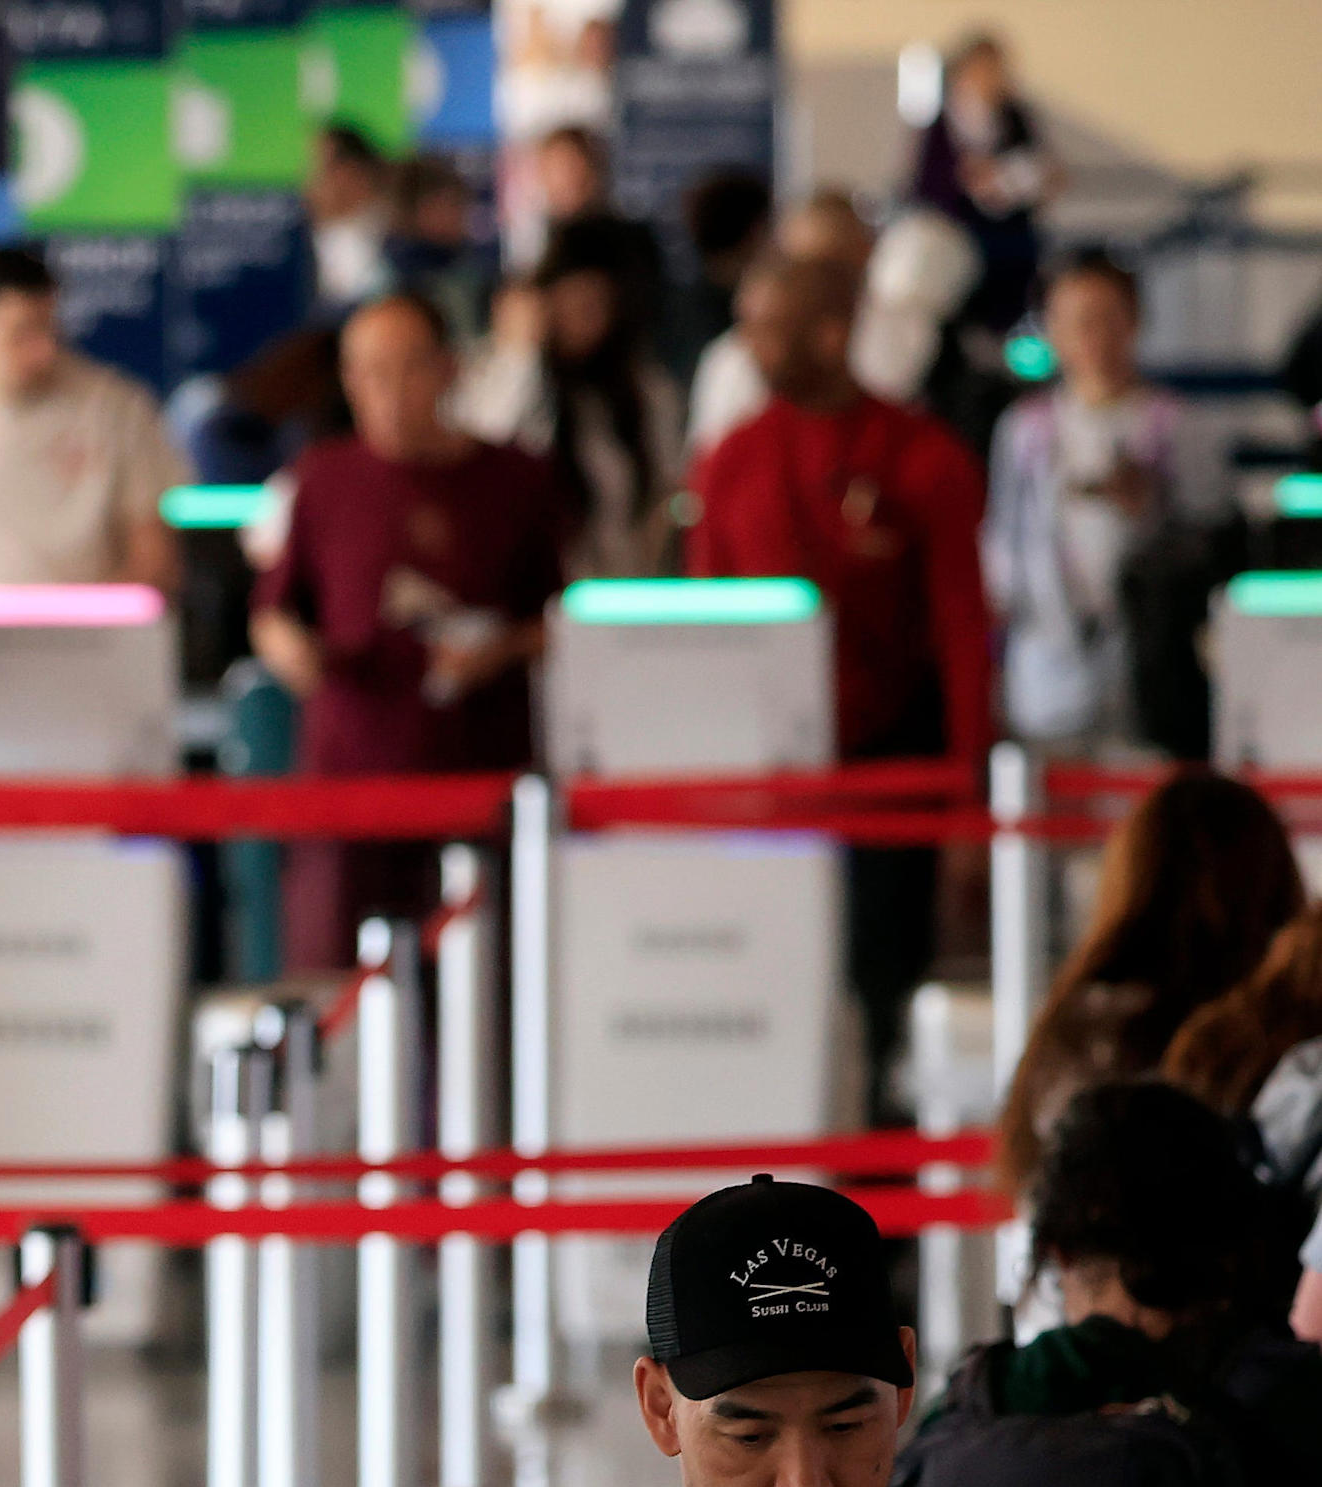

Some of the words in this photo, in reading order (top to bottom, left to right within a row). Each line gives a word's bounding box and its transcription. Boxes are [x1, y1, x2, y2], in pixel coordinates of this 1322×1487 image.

[730, 1249, 768, 1287] LAS
[771, 1238, 838, 1279] VEGAS
[751, 1304, 790, 1318] SUSHI
[795, 1301, 830, 1314] CLUB
